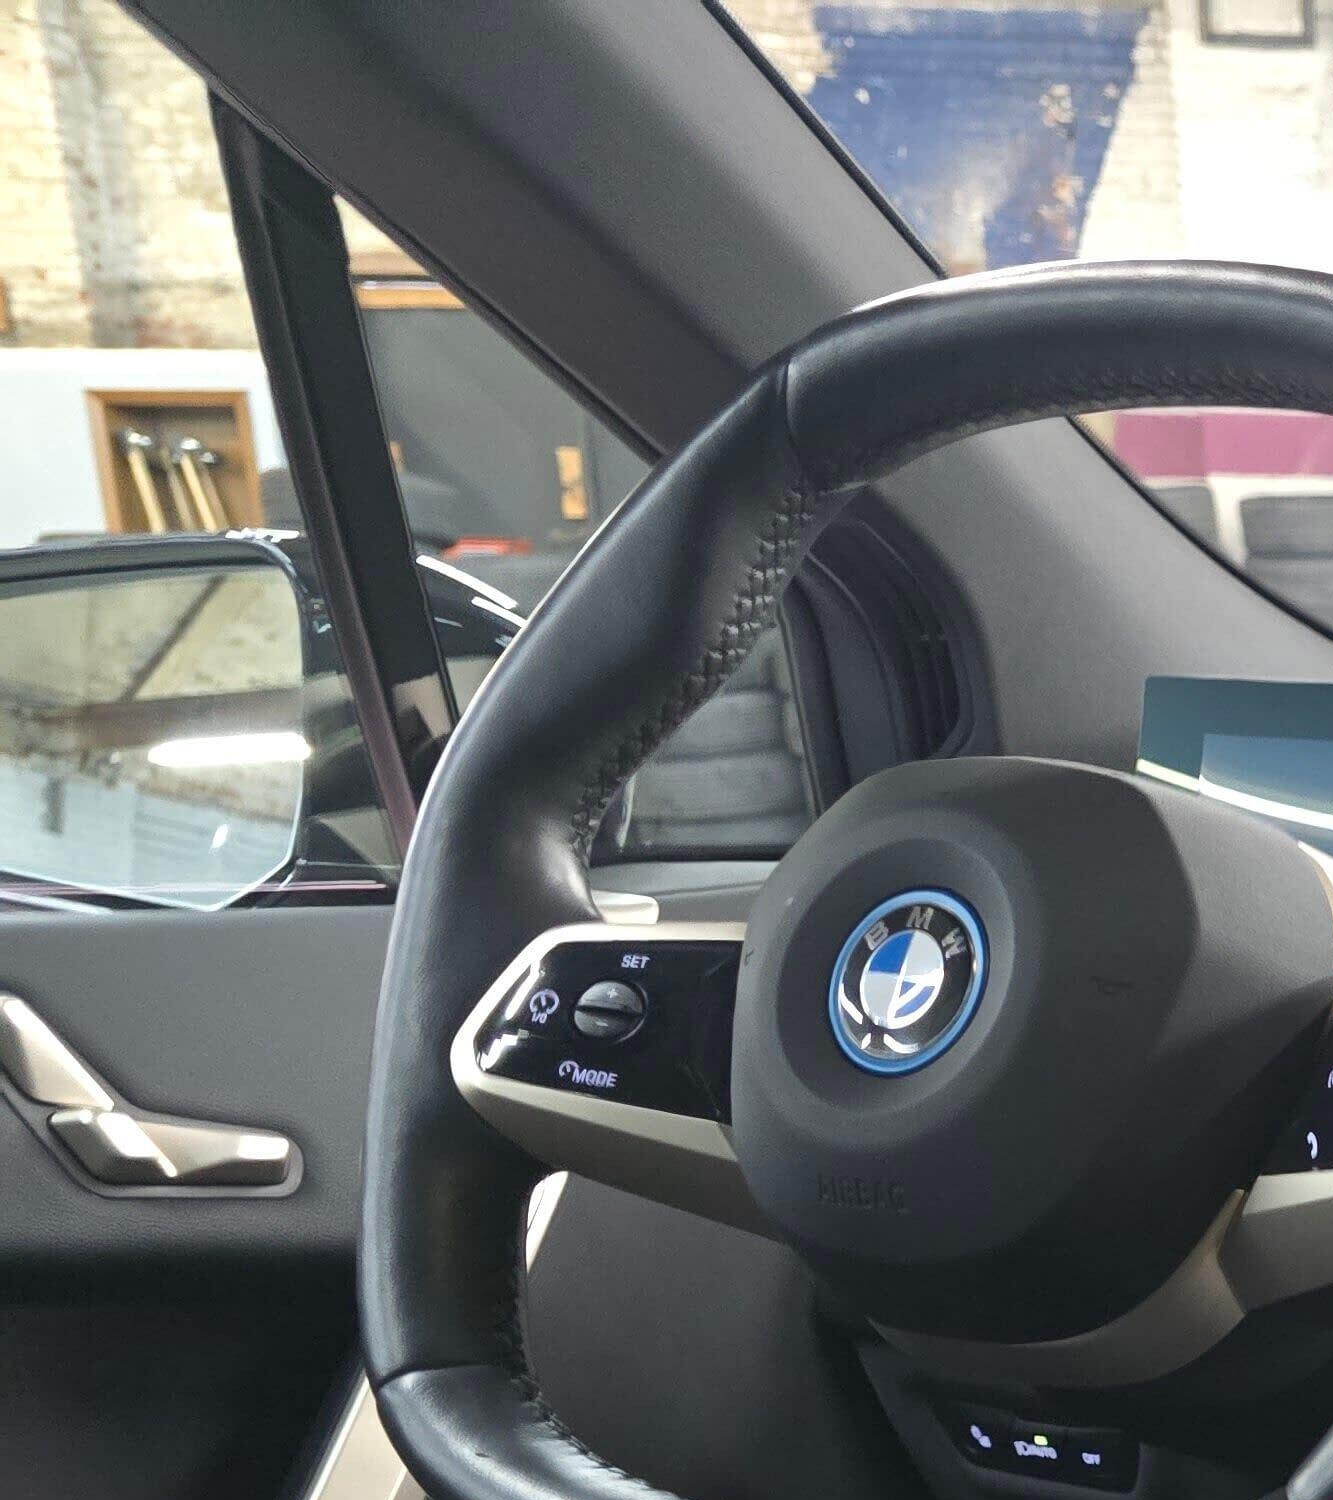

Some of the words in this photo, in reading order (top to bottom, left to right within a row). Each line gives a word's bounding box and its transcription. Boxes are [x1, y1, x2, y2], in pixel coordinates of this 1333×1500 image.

[864, 905, 968, 960] BMW
[621, 954, 651, 970] SET
[572, 1067, 618, 1088] MODE
